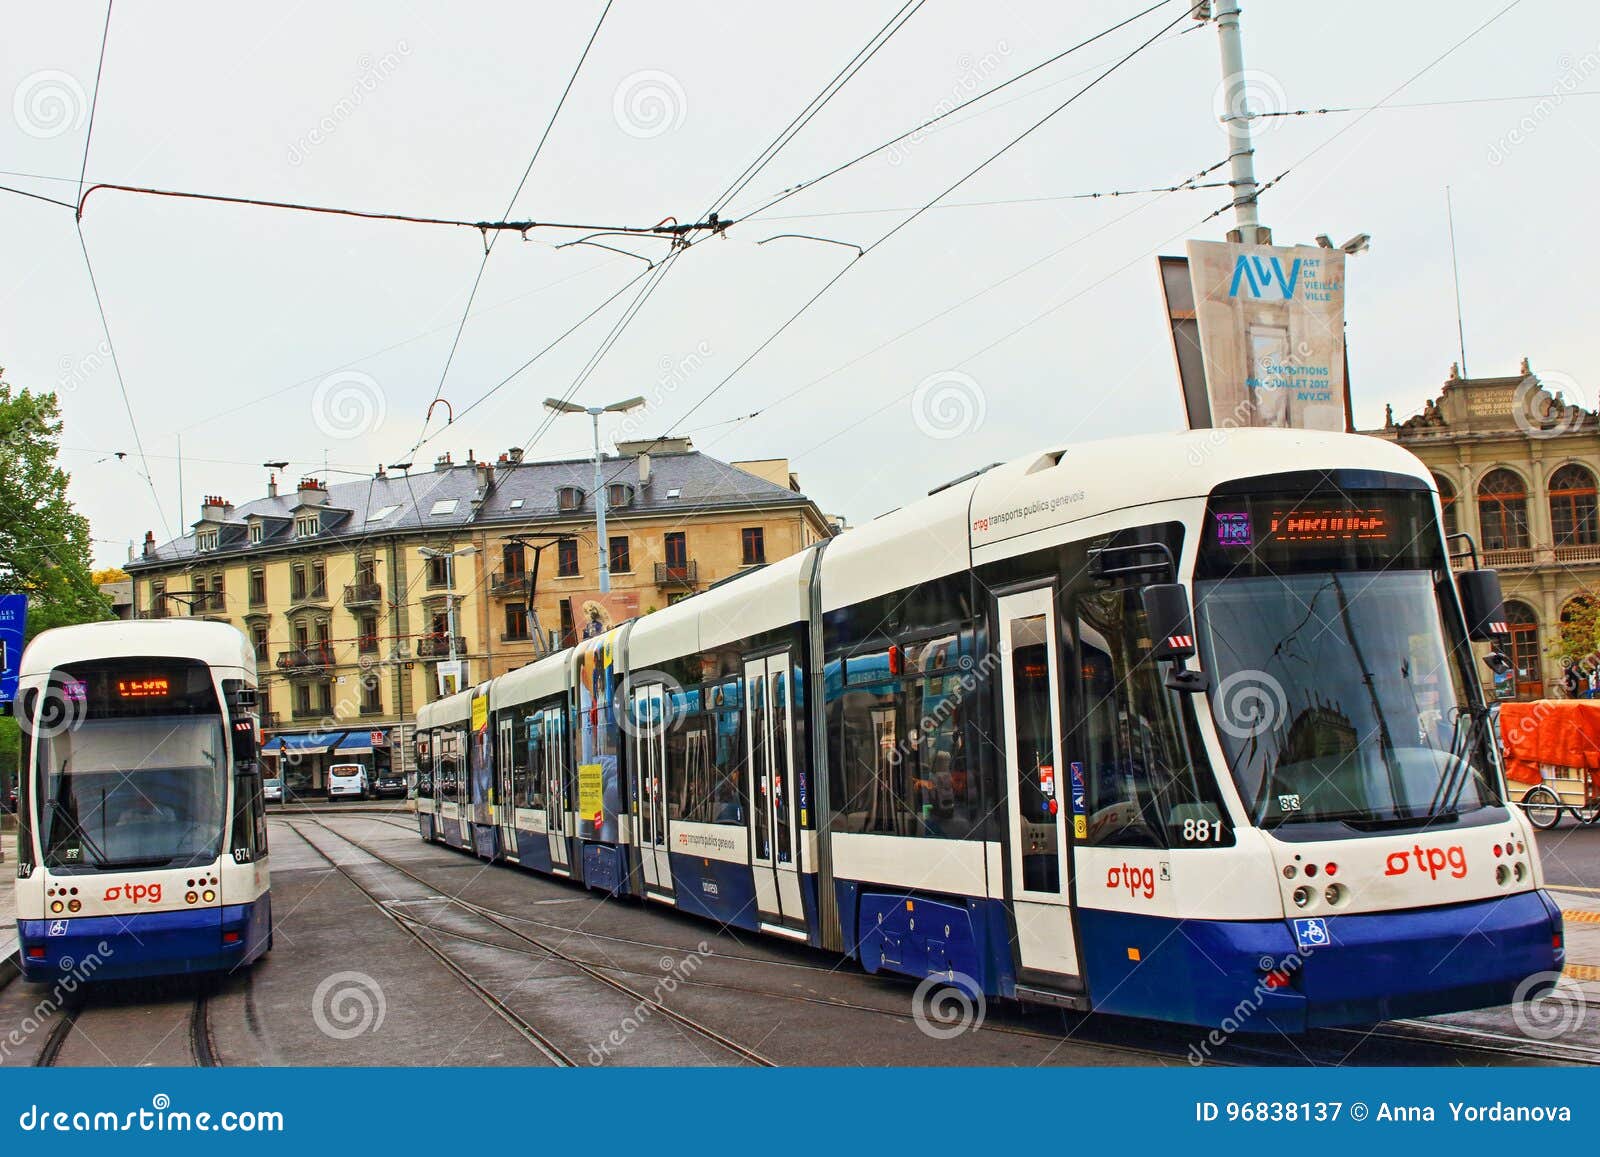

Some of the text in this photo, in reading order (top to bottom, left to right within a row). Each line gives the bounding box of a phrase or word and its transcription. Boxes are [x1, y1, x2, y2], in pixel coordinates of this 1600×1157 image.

[1303, 259, 1320, 267] ART
[1303, 270, 1315, 278] EN
[1305, 292, 1331, 301] VILLE
[988, 507, 1024, 526] transports
[1023, 500, 1050, 520] publics
[1049, 489, 1085, 512] genevois
[1183, 818, 1222, 842] 881
[235, 848, 250, 861] 874
